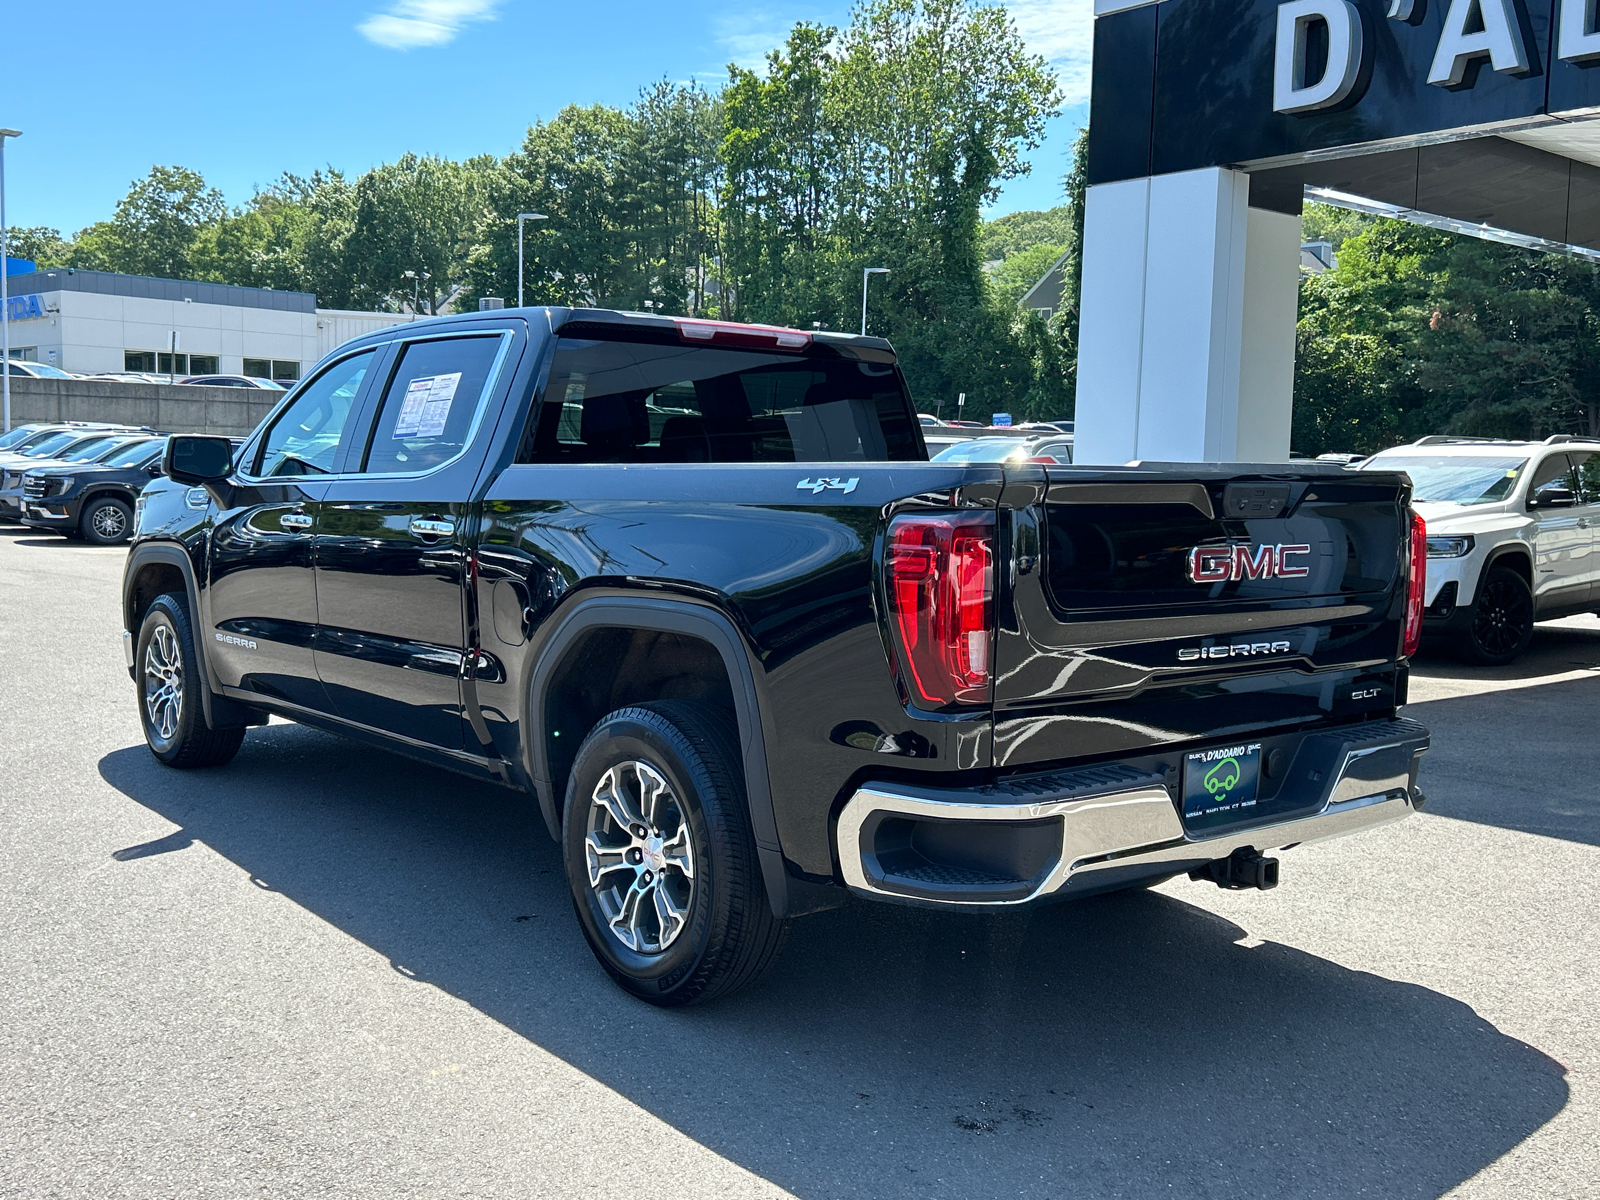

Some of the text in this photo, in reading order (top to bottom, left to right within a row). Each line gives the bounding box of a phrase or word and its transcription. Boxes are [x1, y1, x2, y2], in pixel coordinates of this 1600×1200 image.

[1186, 543, 1311, 583] GMC
[215, 633, 258, 650] SIERRA
[1177, 641, 1290, 661] SIERRA
[1351, 687, 1382, 700] SLT
[1207, 746, 1245, 761] D'ADDARIO
